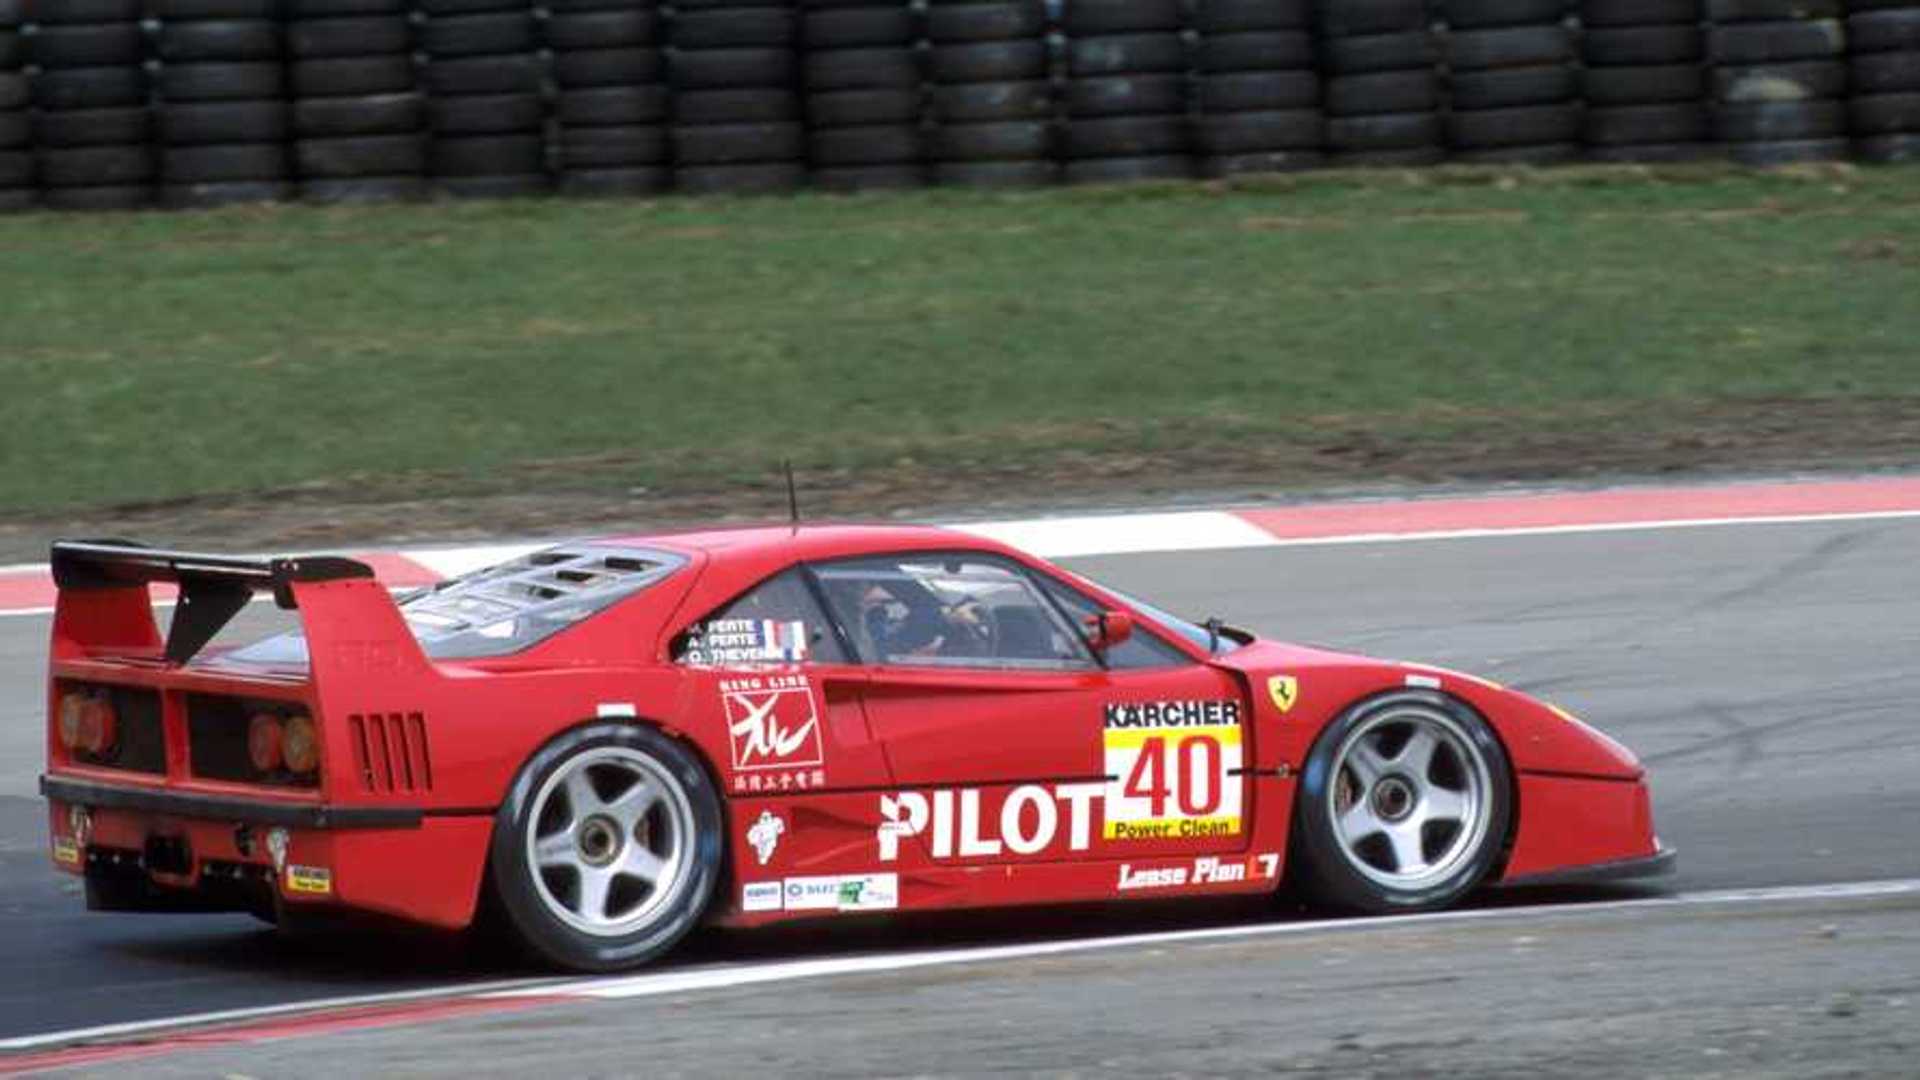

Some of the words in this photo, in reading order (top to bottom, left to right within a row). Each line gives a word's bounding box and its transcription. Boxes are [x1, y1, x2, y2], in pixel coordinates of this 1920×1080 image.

[1123, 735, 1222, 817] 40
[878, 783, 1105, 861] PILOT
[1115, 821, 1170, 838] Power
[1179, 819, 1230, 836] Clean
[1118, 864, 1187, 890] Lease
[1192, 855, 1246, 884] Plan
